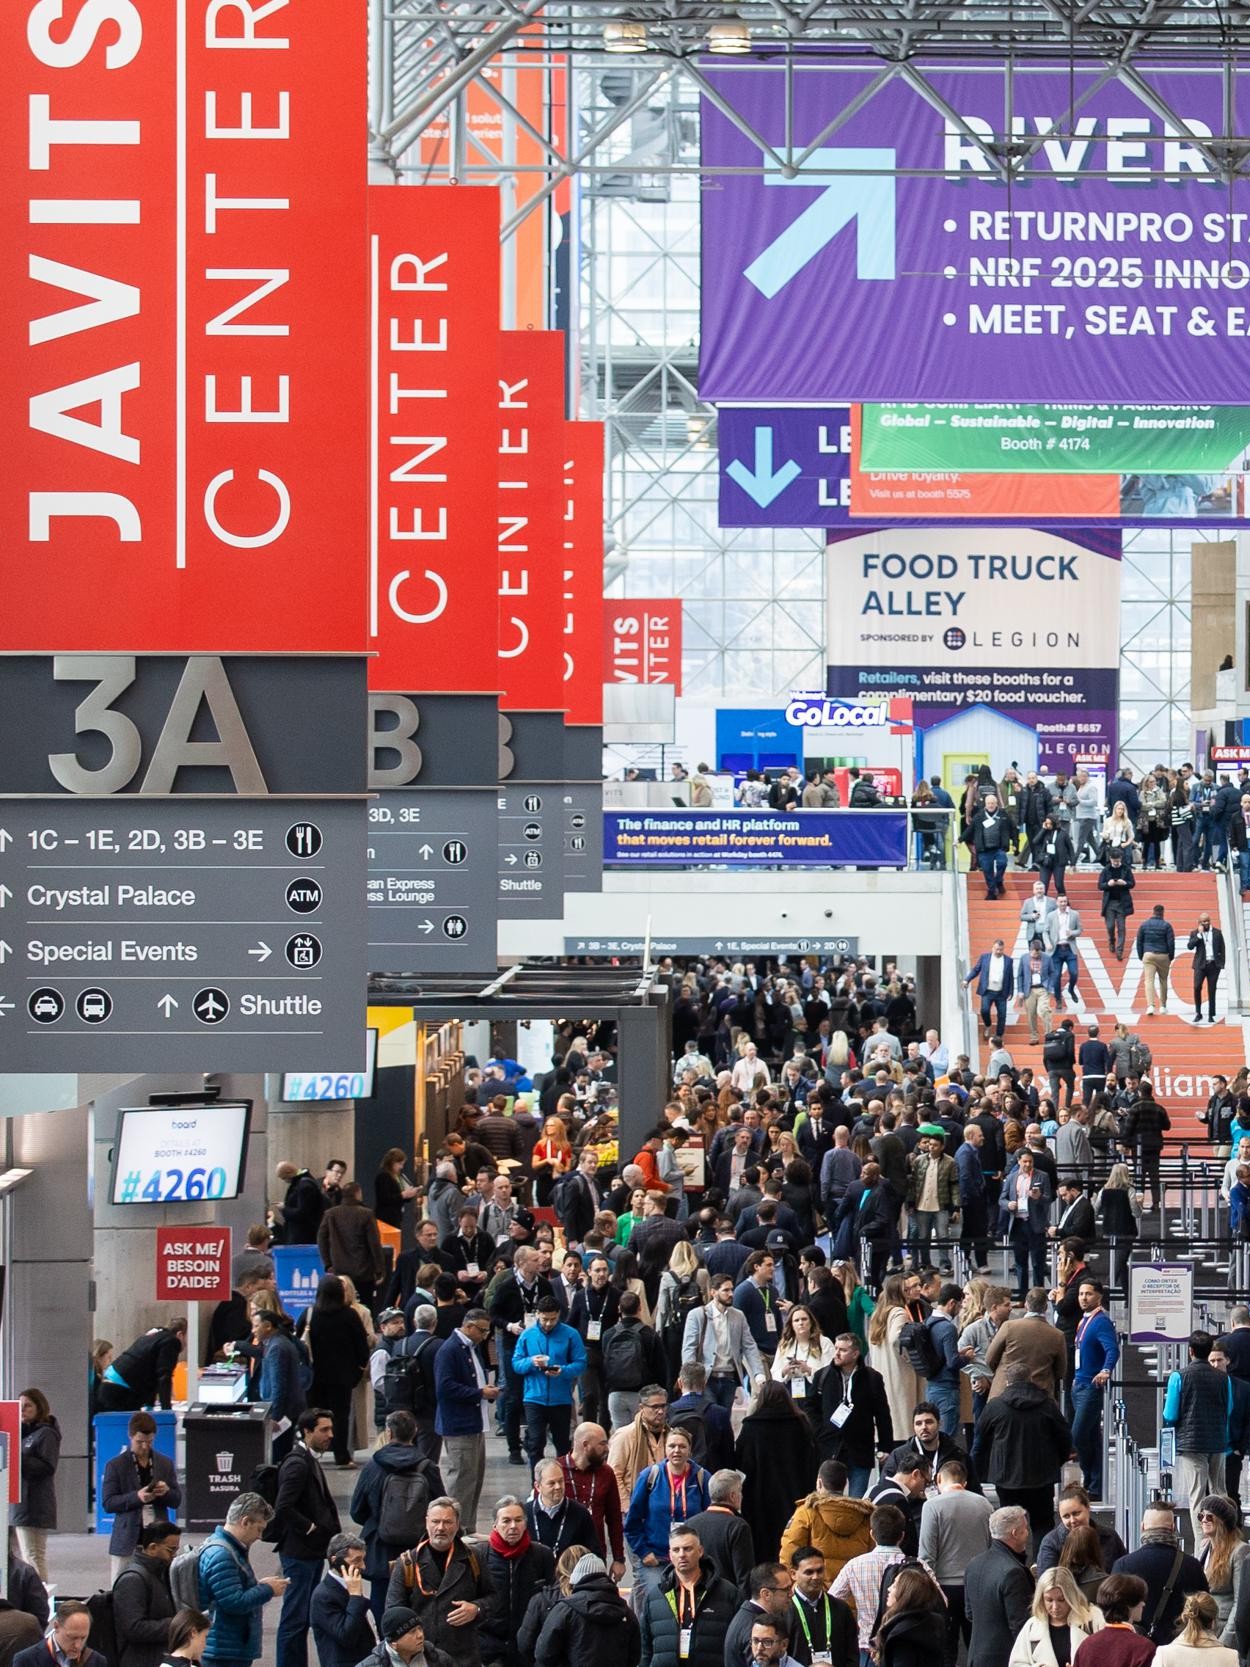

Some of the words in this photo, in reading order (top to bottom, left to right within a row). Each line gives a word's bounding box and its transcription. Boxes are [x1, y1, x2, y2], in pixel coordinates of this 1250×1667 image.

[944, 116, 1216, 183] RIVER
[969, 210, 1193, 242] RETURNPRO
[28, 0, 142, 542] JAVITS
[204, 0, 290, 548] CENTER
[969, 257, 1040, 288] NRF
[1051, 256, 1143, 289] 2025
[969, 304, 1075, 339] MEET,
[1085, 305, 1178, 336] SEAT
[1187, 307, 1216, 337] &
[880, 414, 931, 428] Global
[950, 415, 1040, 429] Sustainable
[1061, 415, 1113, 431] Digital
[1133, 415, 1215, 429] Innovation
[389, 251, 448, 624] CENTER
[1001, 438, 1042, 450] Booth
[1047, 438, 1056, 450] #
[1059, 438, 1091, 450] 4174
[869, 489, 891, 498] Visit
[906, 490, 916, 498] at
[917, 489, 944, 498] booth
[863, 554, 958, 580] FOOD
[967, 555, 1079, 581] TRUCK
[861, 591, 966, 616] ALLEY
[860, 633, 920, 643] SPONSORED
[921, 633, 934, 643] BY
[973, 631, 1080, 648] LEGION
[613, 616, 640, 684] VITS
[858, 672, 921, 687] Retailers,
[923, 672, 950, 686] visit
[953, 672, 991, 686] these
[993, 673, 1040, 687] booths
[1043, 673, 1061, 687] for
[1064, 676, 1074, 687] a
[858, 689, 964, 706] complimentary
[966, 689, 992, 704] $20
[994, 690, 1024, 704] food
[1027, 690, 1087, 705] voucher.
[785, 700, 888, 727] GoLocal
[48, 656, 269, 794] 3A
[368, 694, 422, 786] B
[1045, 743, 1111, 755] LEGION
[1214, 748, 1238, 759] ASK
[1074, 754, 1094, 762] ASK
[368, 808, 395, 824] 3D,
[399, 808, 421, 823] 3E
[617, 819, 643, 831] The
[644, 818, 694, 831] finance
[694, 818, 721, 831] and
[722, 819, 741, 831] HR
[743, 818, 800, 833] platform
[27, 830, 58, 851] 1C
[85, 830, 121, 854] 1E,
[127, 830, 167, 854] 2D,
[173, 830, 207, 851] 3B
[233, 830, 264, 851] 3E
[617, 834, 646, 846] that
[648, 836, 691, 846] moves
[692, 834, 728, 846] retail
[730, 834, 775, 846] forever
[778, 834, 833, 847] forward.
[386, 878, 435, 893] Express
[500, 879, 543, 891] Shuttle
[27, 884, 110, 910] Crystal
[117, 885, 196, 906] Palace
[289, 889, 319, 903] ATM
[388, 890, 435, 904] Lounge
[26, 941, 113, 964] Special
[120, 941, 198, 962] Events
[650, 941, 677, 951] Palace
[741, 941, 769, 952] Special
[239, 995, 322, 1016] Shuttle
[154, 1150, 182, 1158] BOOTH
[121, 1167, 227, 1202] #4260
[163, 1243, 193, 1255] ASK
[195, 1239, 225, 1258] ME/
[167, 1260, 220, 1272] BESOIN
[167, 1275, 220, 1288] D'AIDE?
[208, 1474, 242, 1483] TRASH
